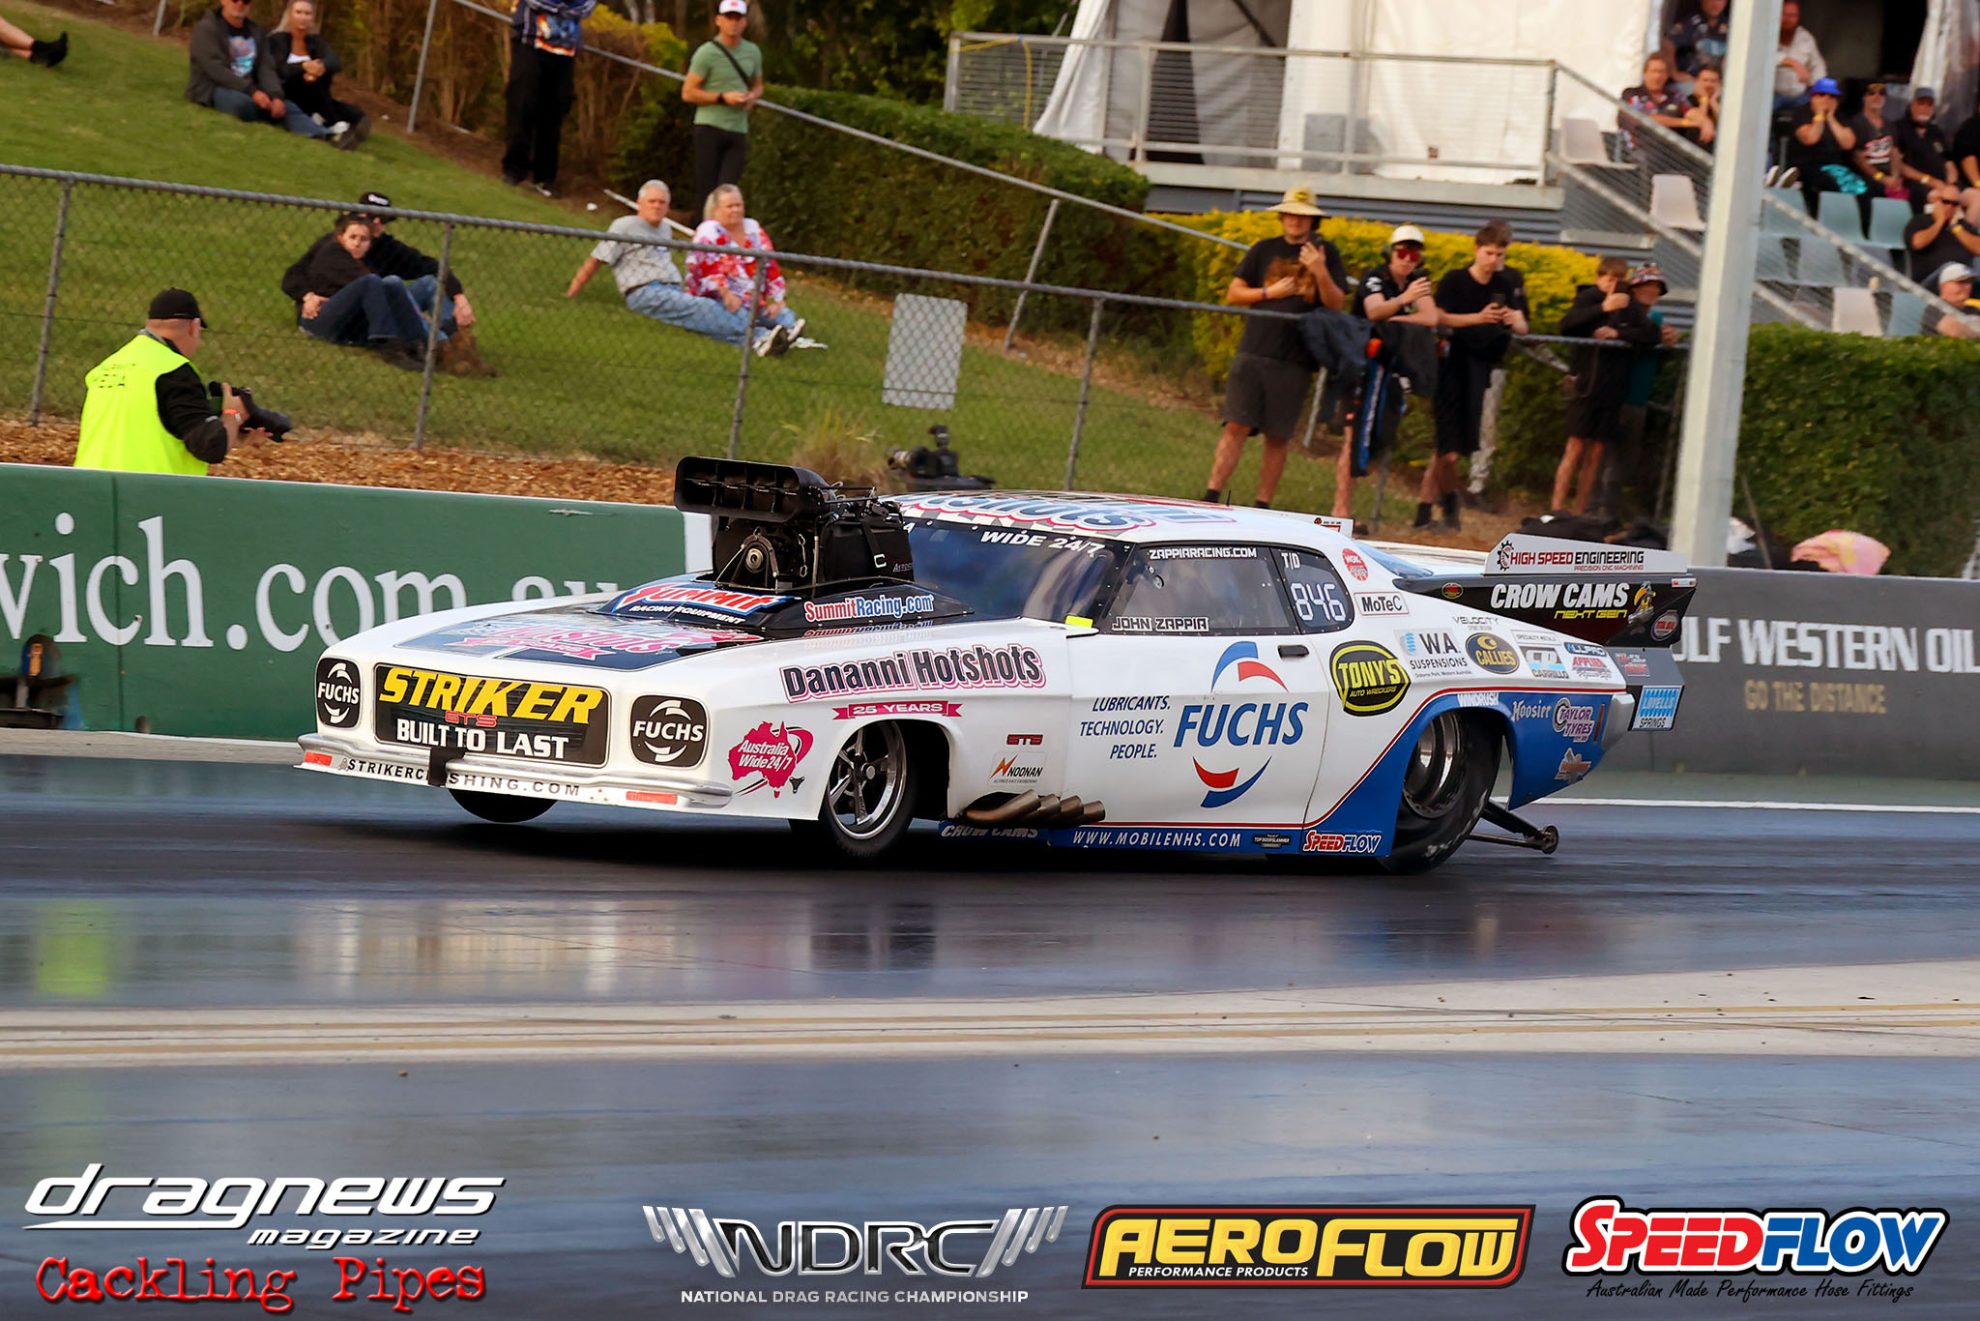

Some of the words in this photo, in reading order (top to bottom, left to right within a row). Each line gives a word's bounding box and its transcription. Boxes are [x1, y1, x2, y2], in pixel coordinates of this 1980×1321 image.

[980, 530, 1047, 548] WIDE
[1048, 537, 1106, 556] 24/7
[1148, 547, 1257, 560] ZAPPIARACING.COM
[1281, 552, 1301, 570] T/D
[1510, 551, 1535, 565] HIGH
[1537, 551, 1574, 565] SPEED
[1575, 551, 1644, 564] ENGINEERING
[618, 582, 779, 615] SUMMIT
[1290, 582, 1346, 622] 846
[1360, 594, 1404, 613] MoTeC
[1490, 583, 1562, 609] CROW
[1562, 582, 1631, 609] CAMS
[628, 604, 675, 614] RACING
[674, 606, 748, 625] EQUIPMENT
[803, 593, 935, 623] SummitRacing.com
[1554, 610, 1596, 619] NEXT
[1595, 609, 1628, 619] GEN
[1111, 616, 1151, 632] JOHN
[1153, 616, 1209, 632] ZAPPIA
[1452, 616, 1500, 625] VELOCITY
[1418, 632, 1462, 655] W.A.
[1738, 618, 1919, 672] WESTERN
[1925, 627, 1980, 674] OIL
[1409, 657, 1468, 670] SUSPENSIONS
[1475, 649, 1517, 666] CALLIES
[783, 651, 908, 699] Dananni
[913, 647, 1044, 688] Hotshots
[1338, 659, 1402, 691] TONY'S
[317, 681, 361, 705] FUCHS
[378, 666, 605, 725] STRIKER
[1744, 679, 1769, 712] GO
[1772, 680, 1805, 713] THE
[1809, 681, 1888, 715] DISTANCE
[851, 705, 879, 717] 25
[885, 702, 944, 715] YEARS
[1092, 695, 1171, 713] LUBRICANTS.
[1510, 699, 1552, 722] Hoosier
[1560, 707, 1592, 721] TAYLOR
[632, 719, 705, 742] FUCHS
[1079, 719, 1164, 737] TECHNOLOGY.
[1172, 701, 1309, 749] FUCHS
[1565, 723, 1593, 736] TYRES
[396, 718, 450, 748] BUILT
[455, 727, 487, 752] TO
[497, 731, 570, 760] LAST
[738, 740, 790, 756] Australia
[1109, 743, 1158, 760] PEOPLE.
[738, 754, 768, 769] Wide
[766, 755, 794, 772] 24/7
[1007, 766, 1044, 778] NOONAN
[347, 758, 580, 797] STRIKERCSHING.COM
[1072, 830, 1242, 848] WWW.MOBILENHS.COM
[1303, 830, 1382, 853] SPEEDFLOW
